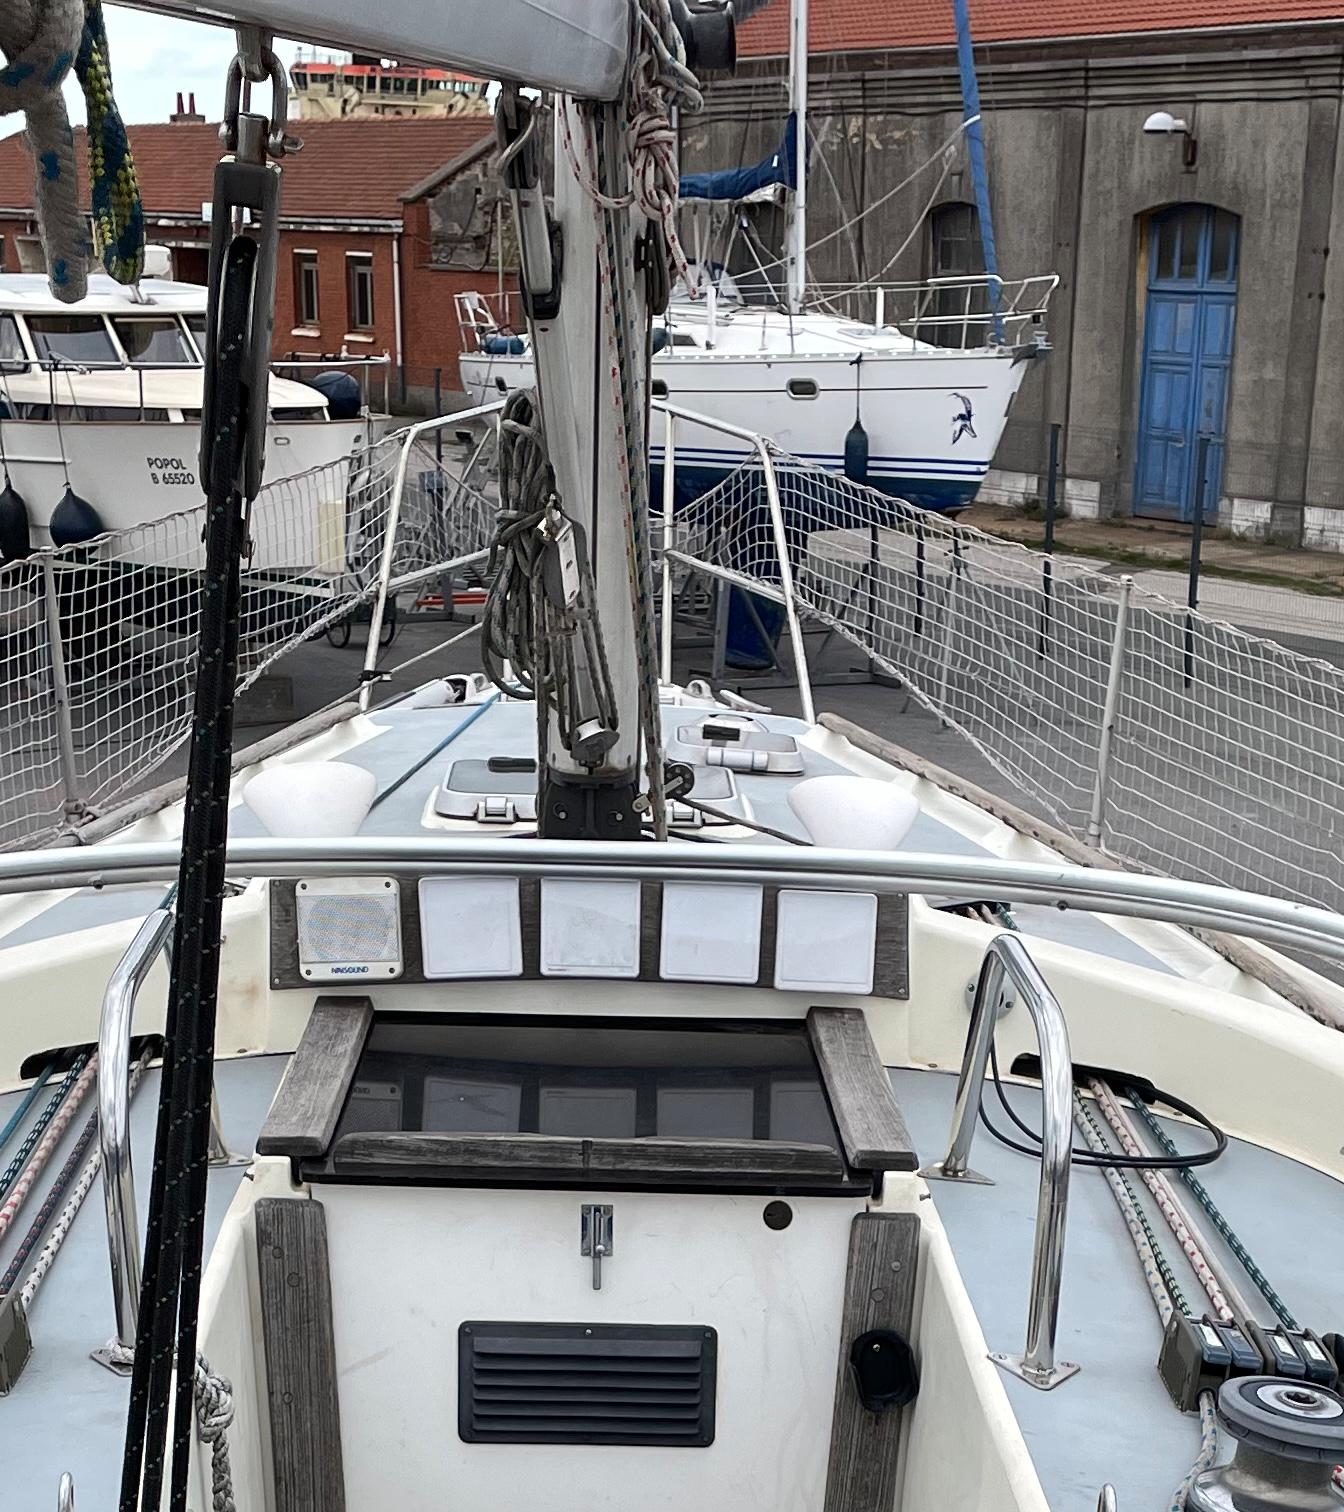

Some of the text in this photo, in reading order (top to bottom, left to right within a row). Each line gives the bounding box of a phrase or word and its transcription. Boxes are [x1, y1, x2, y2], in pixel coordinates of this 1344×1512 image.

[146, 457, 188, 470] POPOL
[150, 472, 195, 485] B 65520
